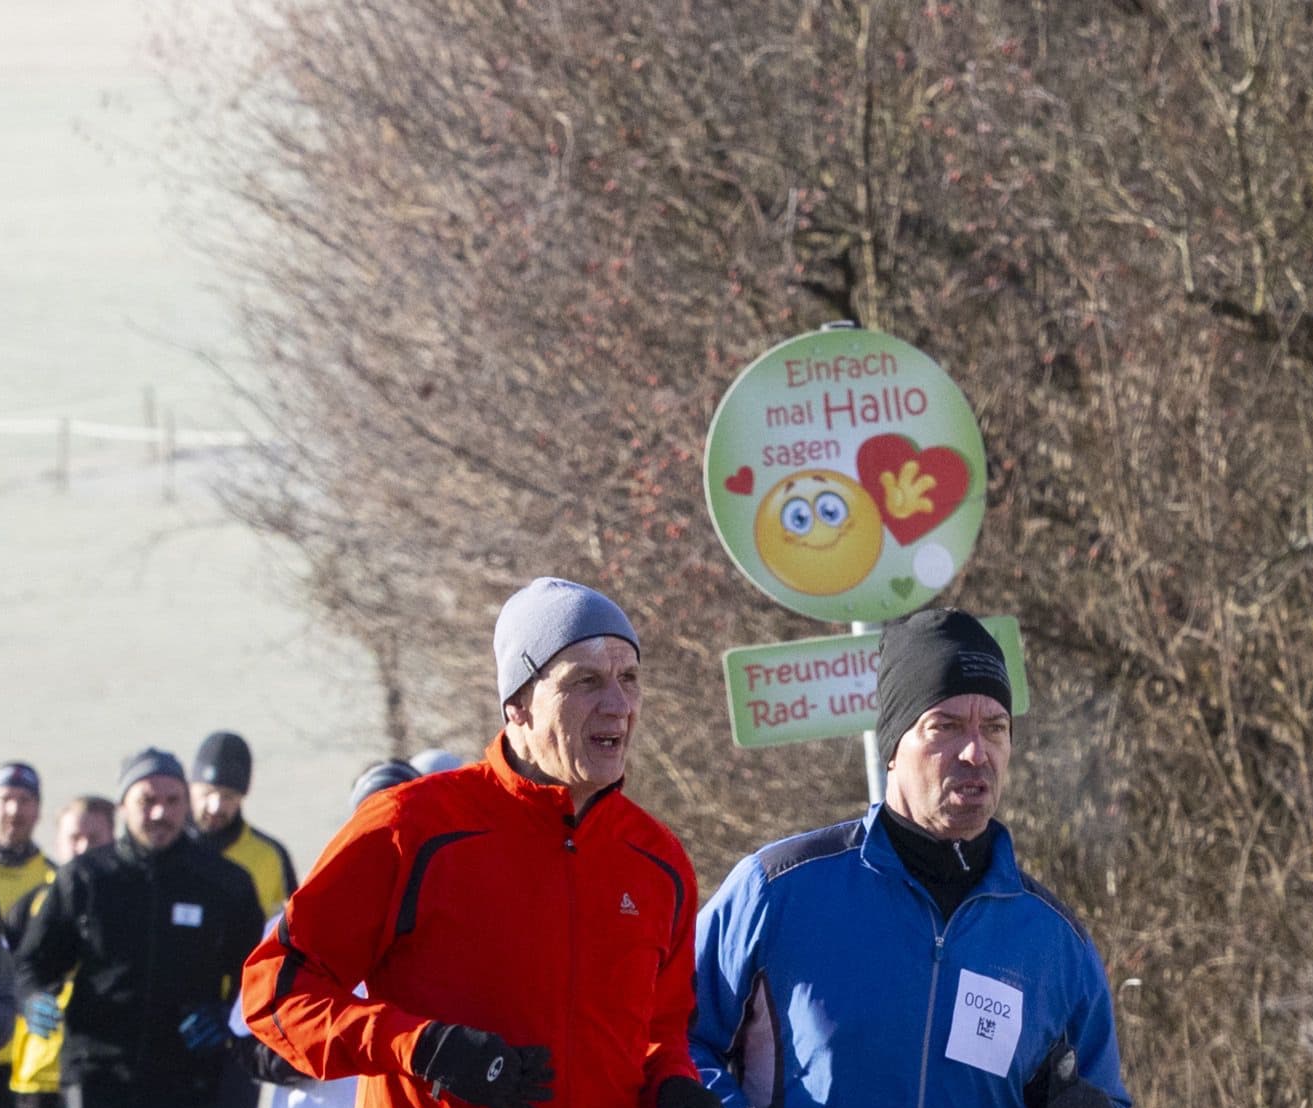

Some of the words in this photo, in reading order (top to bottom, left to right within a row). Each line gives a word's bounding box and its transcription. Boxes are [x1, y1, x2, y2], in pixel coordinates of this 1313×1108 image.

[784, 352, 898, 388] Einfach
[766, 400, 814, 427] mal
[823, 385, 928, 430] Hallo
[762, 438, 841, 467] sagen
[744, 650, 881, 691] Freundlic
[746, 693, 819, 728] Rad-
[964, 992, 1012, 1019] 00202
